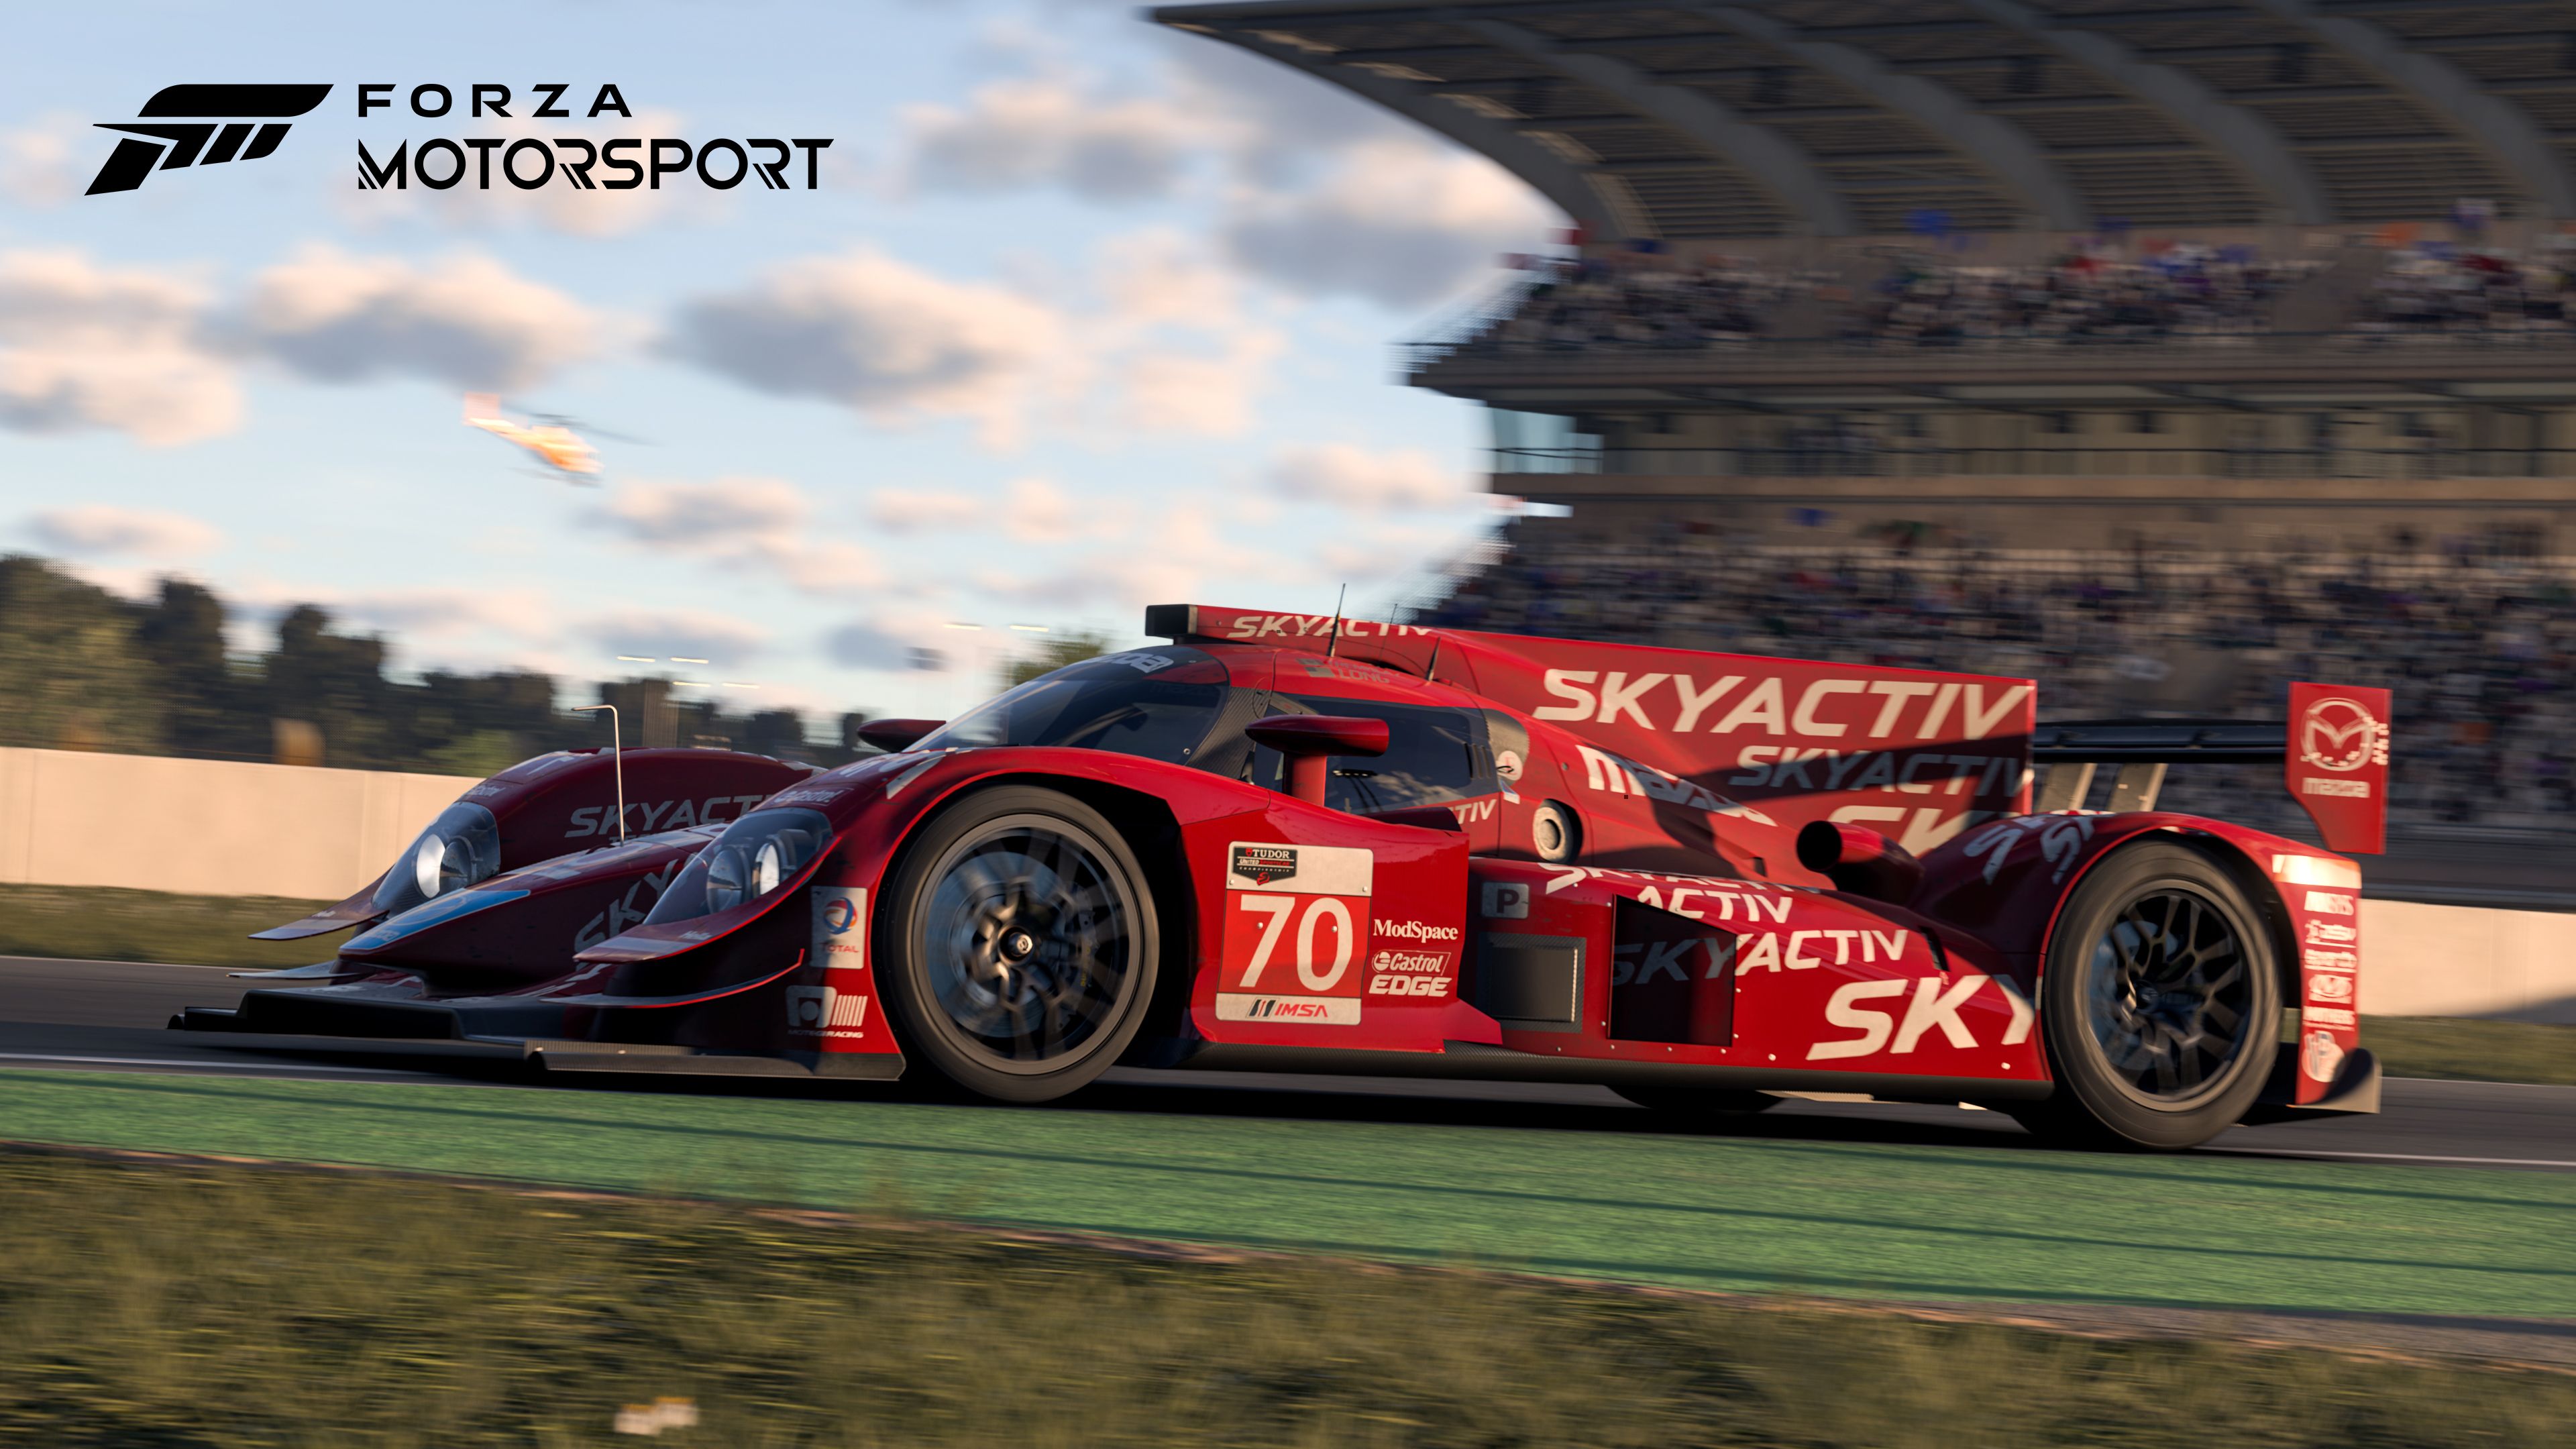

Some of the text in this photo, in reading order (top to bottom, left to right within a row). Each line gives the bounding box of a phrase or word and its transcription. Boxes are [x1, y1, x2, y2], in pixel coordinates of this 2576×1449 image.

[1532, 668, 2034, 740] SKYACTIV
[564, 794, 773, 839] SKYACT
[1252, 849, 1289, 859] TUDOR
[1496, 889, 1519, 913] P
[1239, 894, 1353, 991] 70
[1373, 919, 1458, 943] ModSpace
[819, 942, 859, 953] TOTAL
[1389, 953, 1444, 973] Castrol
[1368, 975, 1452, 998] EDGE
[1275, 1003, 1328, 1018] IMSA
